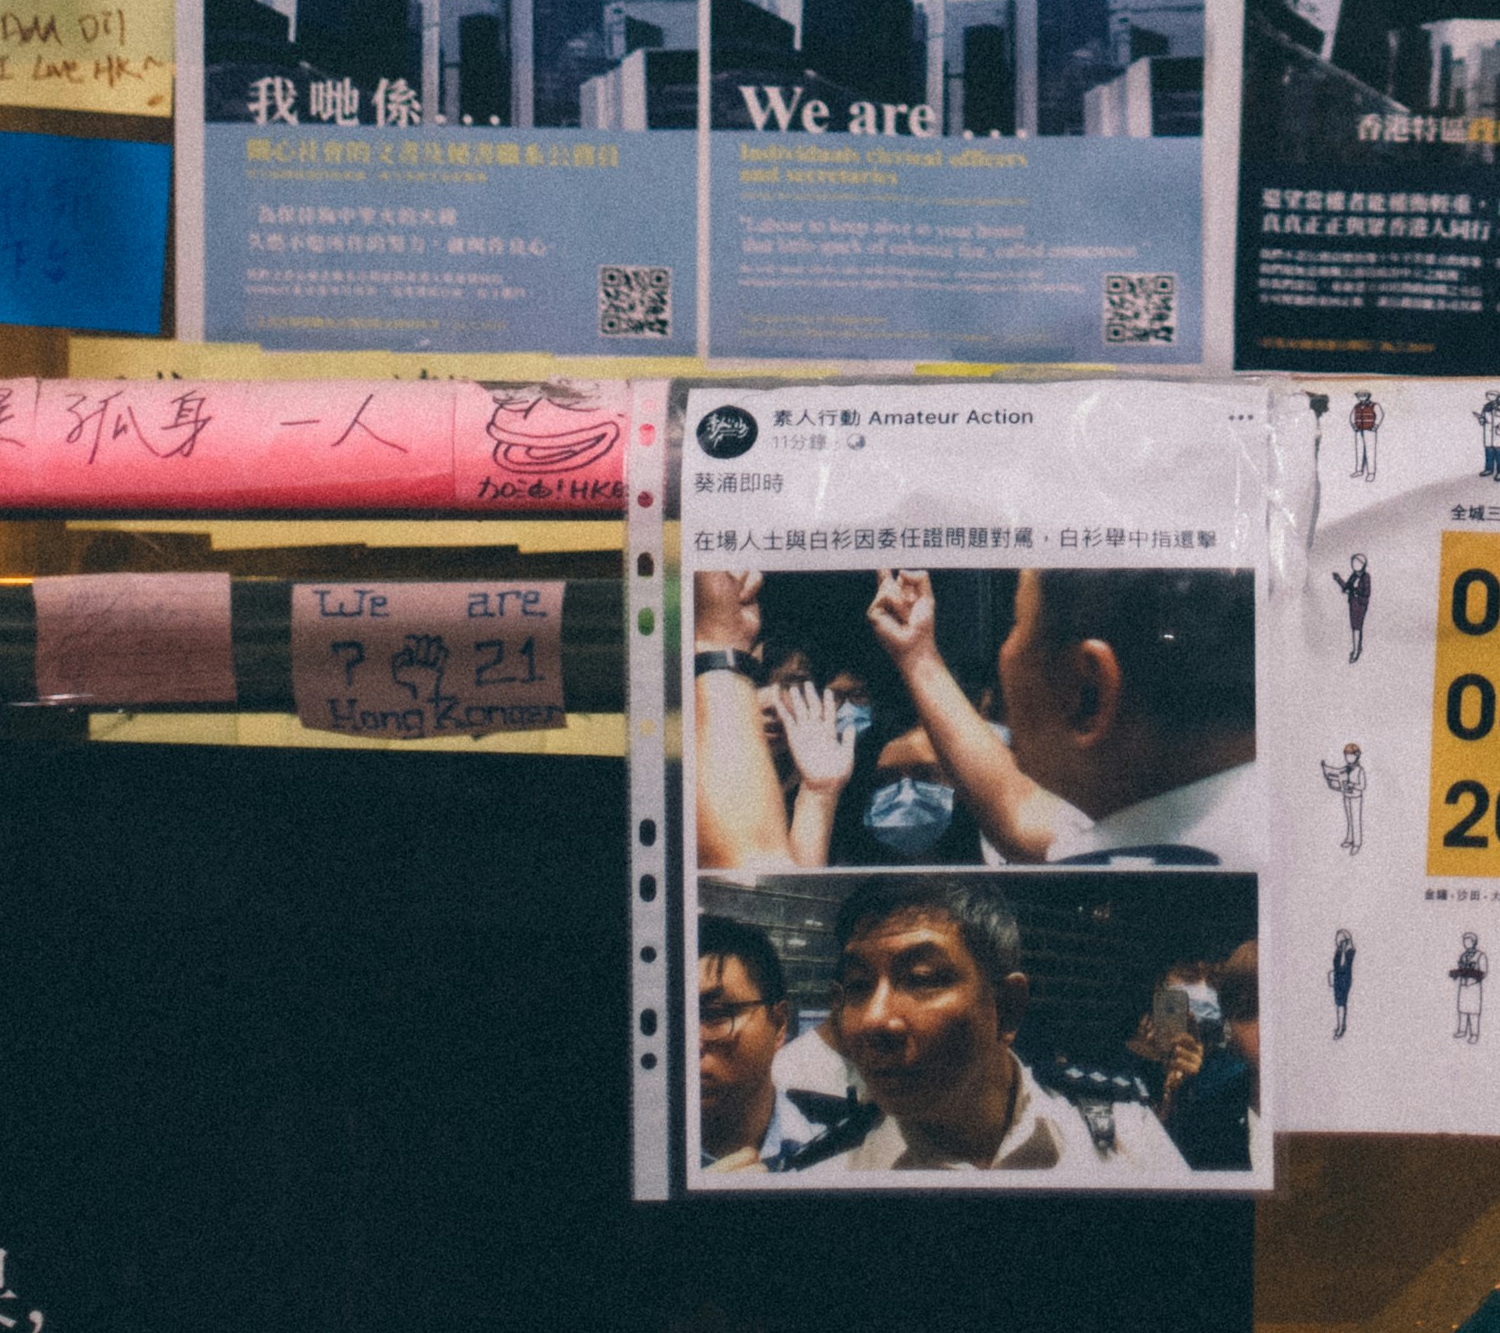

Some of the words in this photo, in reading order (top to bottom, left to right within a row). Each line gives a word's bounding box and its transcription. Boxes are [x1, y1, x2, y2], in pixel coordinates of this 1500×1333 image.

[249, 78, 422, 128] 我哋係
[737, 85, 829, 137] We
[845, 97, 940, 137] are
[772, 407, 861, 428] 素人行動
[869, 408, 958, 427] Amateur
[965, 407, 1034, 427] Action
[694, 470, 785, 495] 葵涌即時
